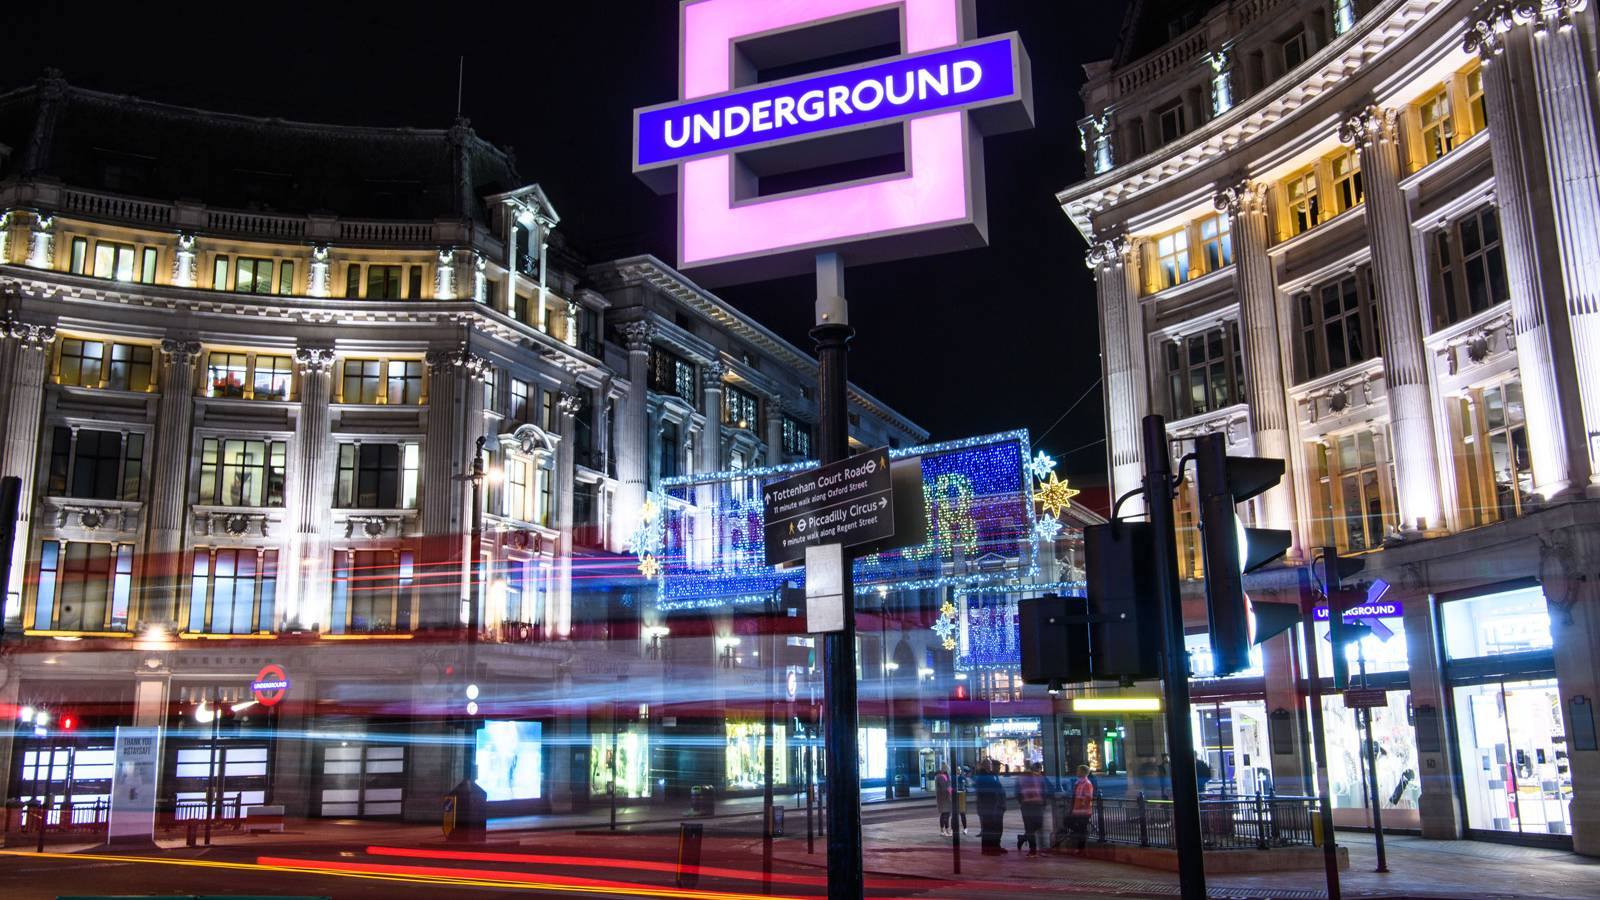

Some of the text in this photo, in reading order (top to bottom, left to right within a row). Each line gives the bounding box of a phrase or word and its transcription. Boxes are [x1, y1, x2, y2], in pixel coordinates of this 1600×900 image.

[663, 59, 983, 149] UNDERGROUND
[773, 466, 867, 502] Tottenham Court Road
[774, 480, 868, 514] 11 minute walk along Oxford Street
[782, 515, 878, 547] 9 minute walk along Regent Street
[808, 501, 878, 528] Piccadilly Circus
[124, 737, 152, 746] THANK YOU
